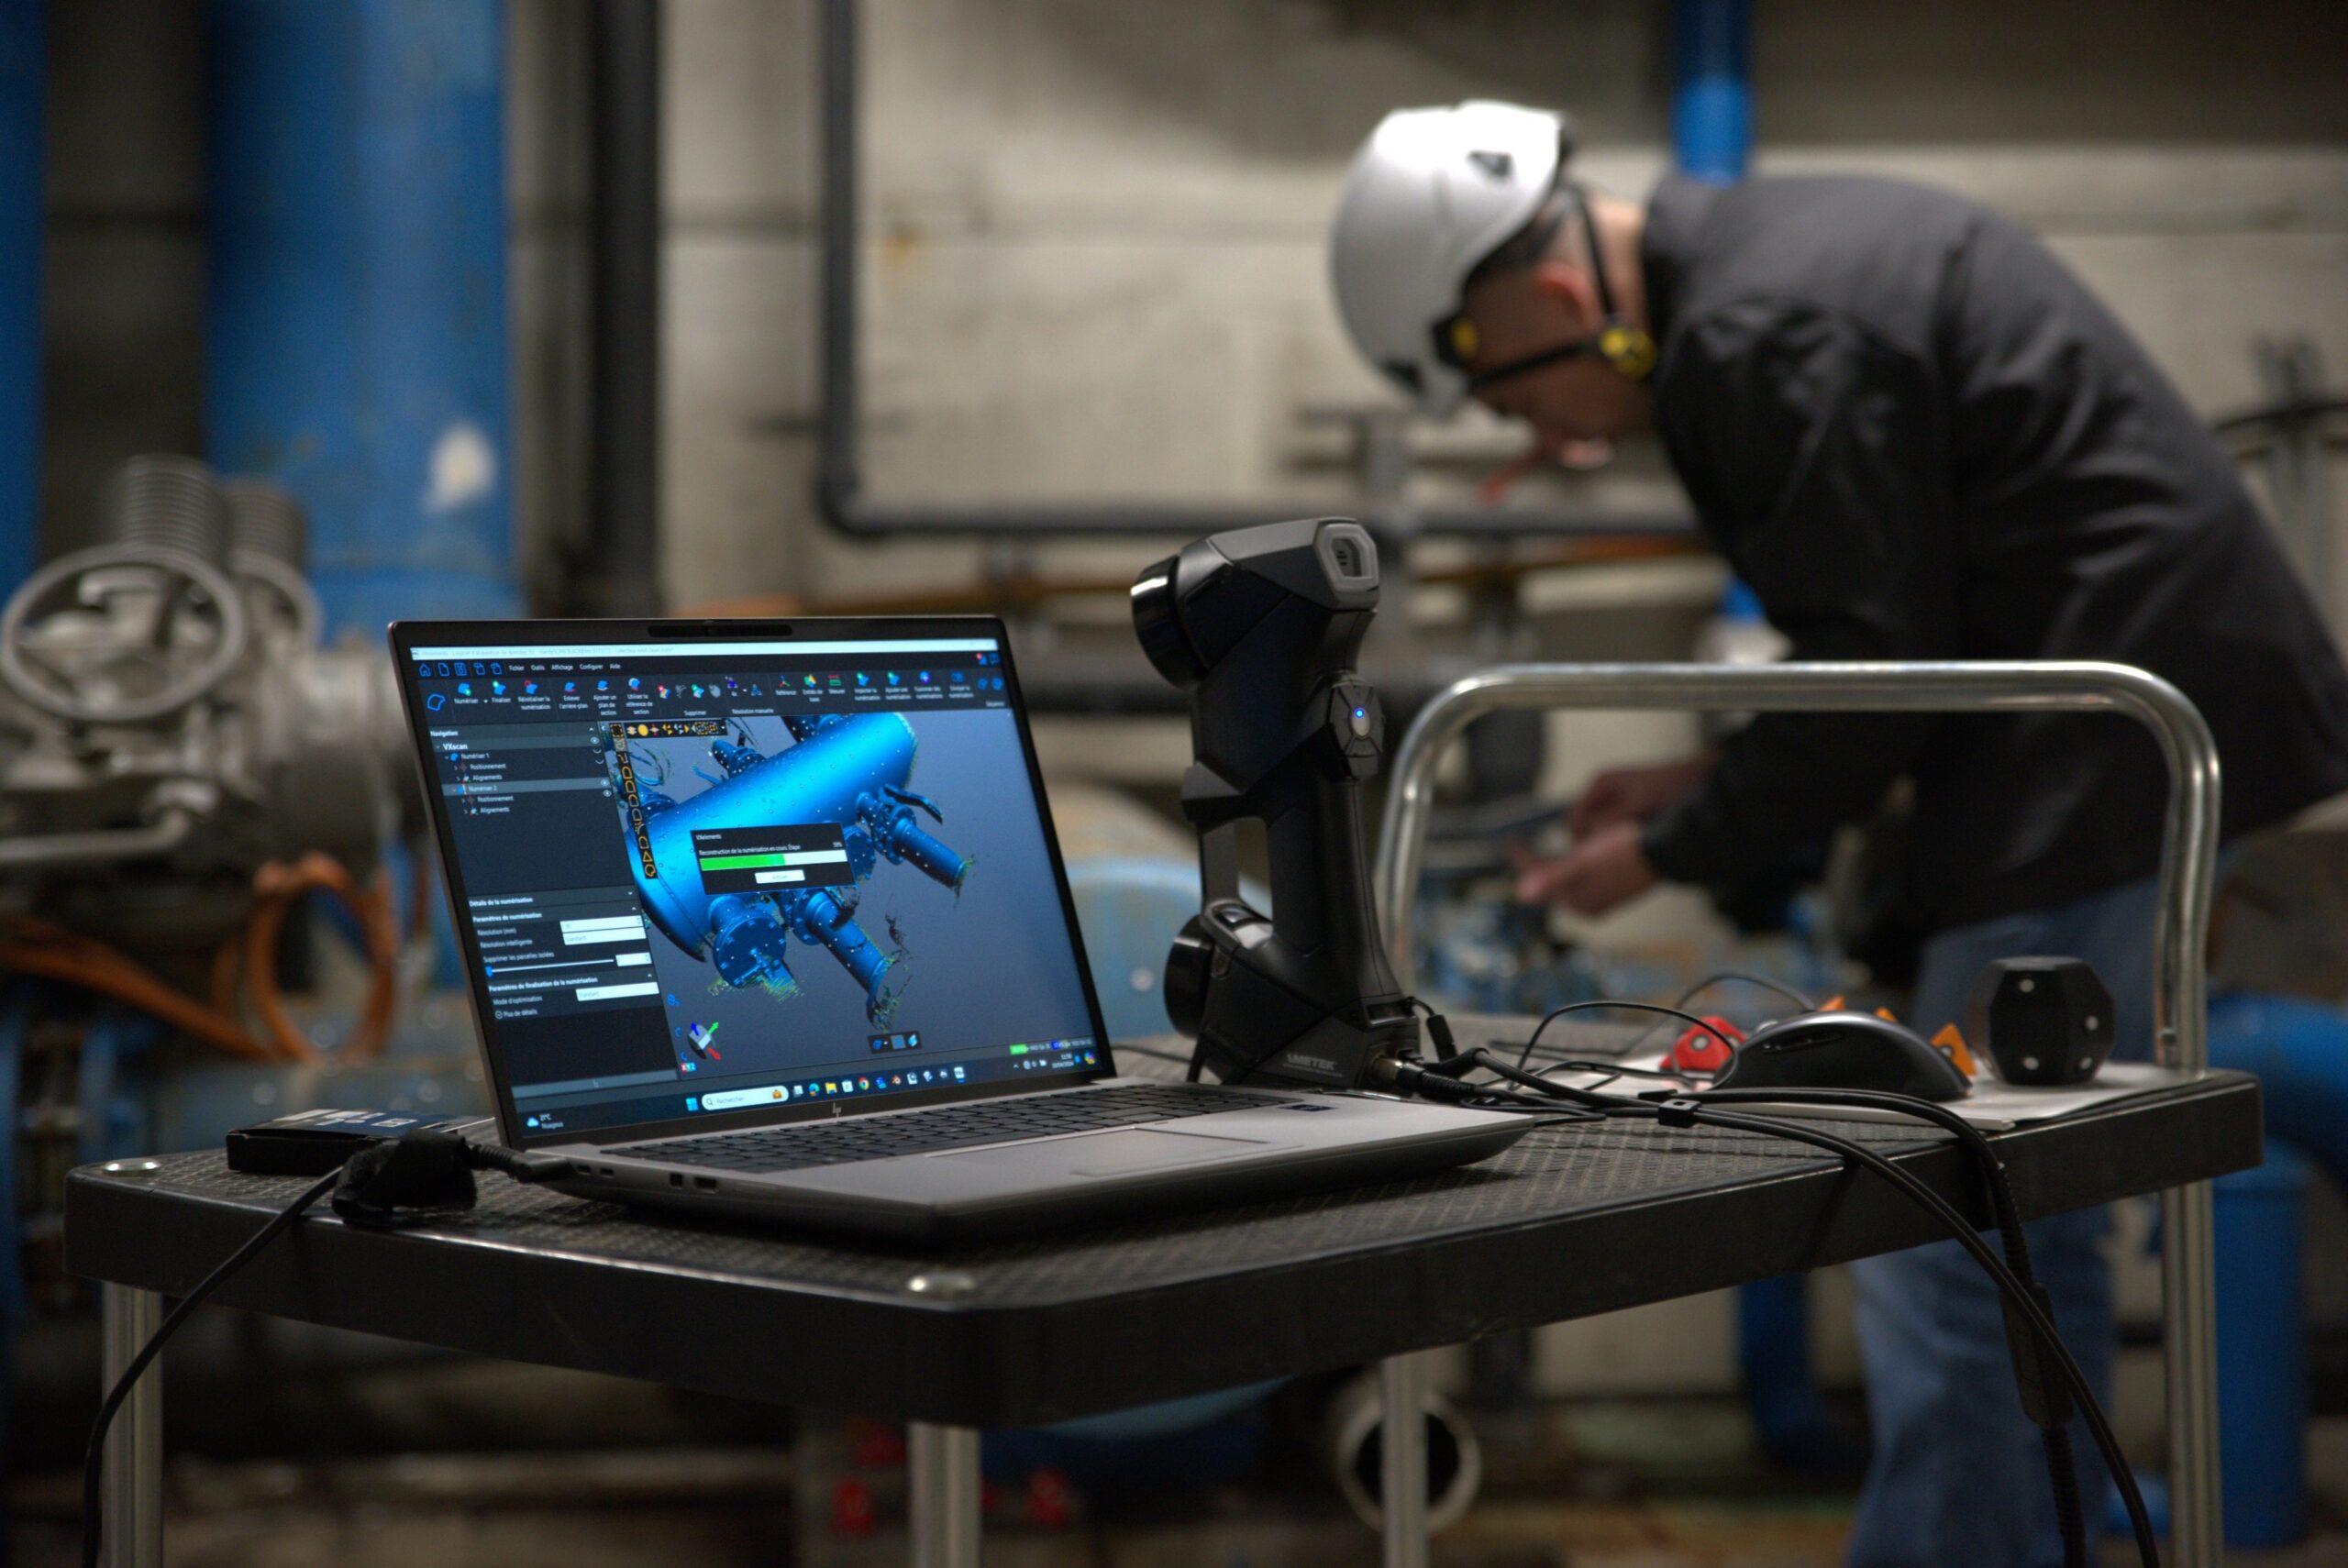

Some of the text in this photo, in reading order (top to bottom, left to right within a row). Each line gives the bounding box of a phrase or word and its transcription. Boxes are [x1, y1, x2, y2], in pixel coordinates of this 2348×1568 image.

[551, 663, 573, 671] Affichage
[580, 663, 604, 671] Configurer
[429, 730, 459, 738] Navigation
[442, 743, 469, 751] VXscan
[469, 899, 487, 907] Détails
[501, 896, 534, 905] numérisation
[509, 911, 542, 920] numérisation
[483, 955, 508, 964] Supprimer
[566, 976, 598, 984] numérisation
